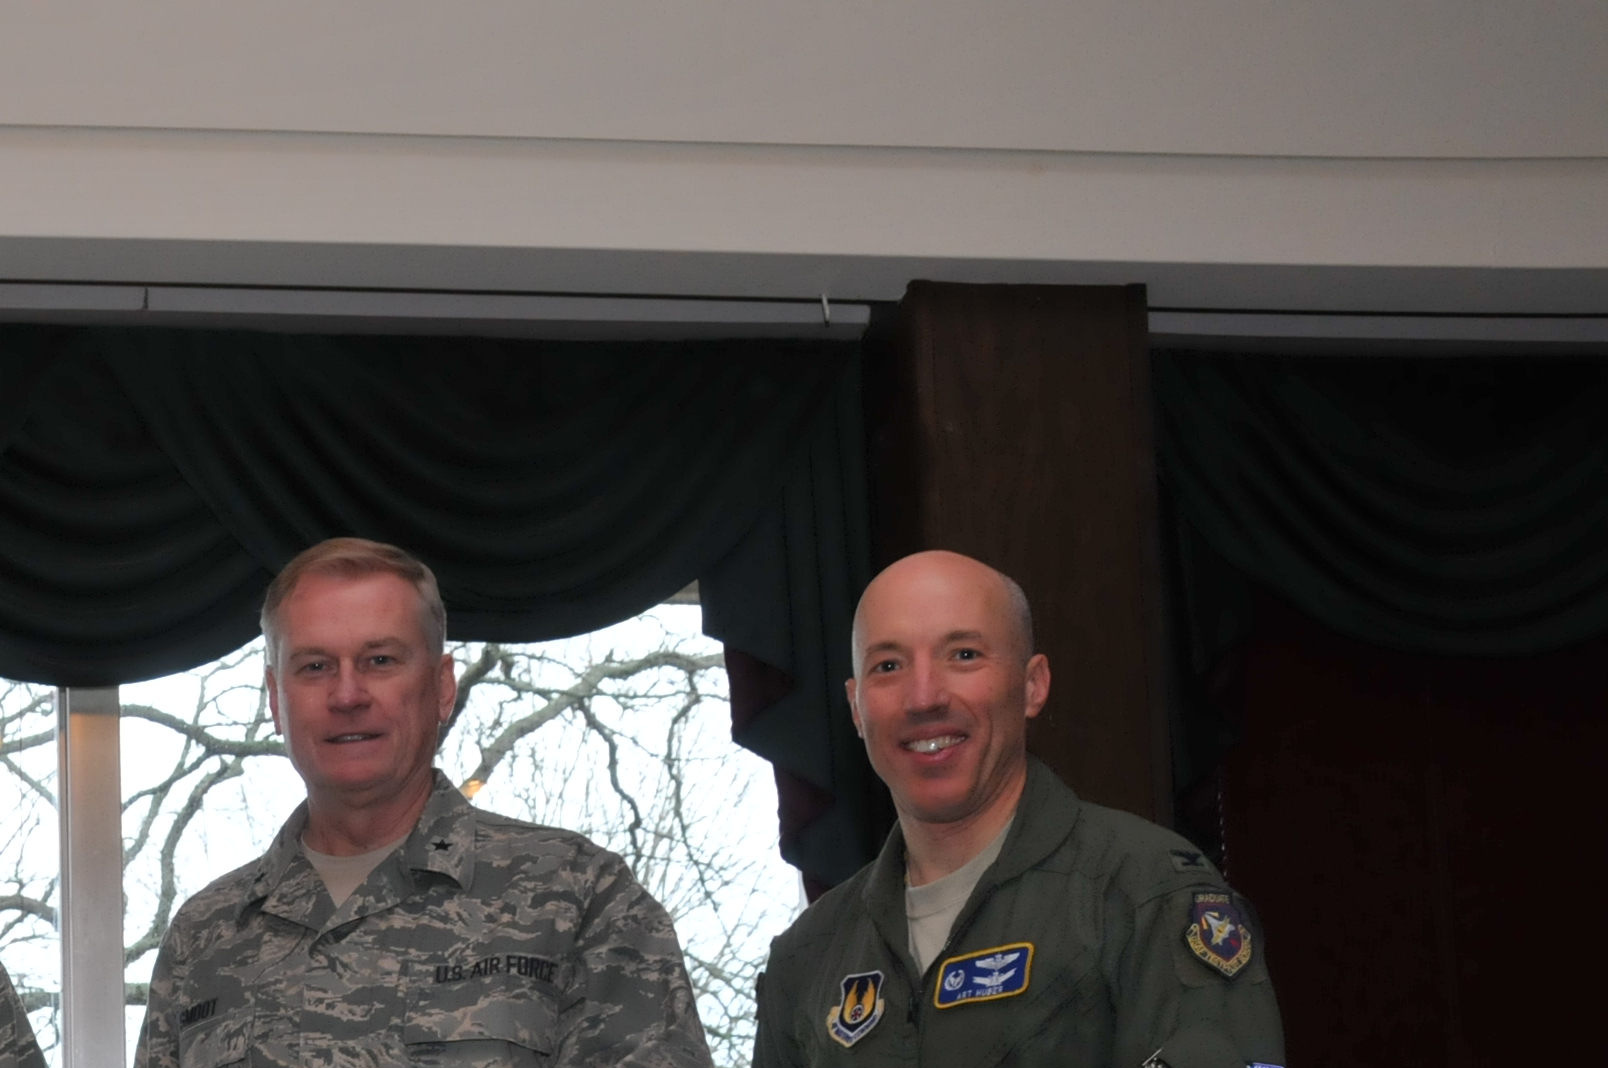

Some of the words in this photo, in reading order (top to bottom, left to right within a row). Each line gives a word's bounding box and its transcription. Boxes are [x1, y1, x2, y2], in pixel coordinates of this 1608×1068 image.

[435, 964, 466, 984] U.S.
[469, 957, 500, 977] AIR
[505, 955, 559, 984] FORCE
[975, 985, 1004, 997] HUBER
